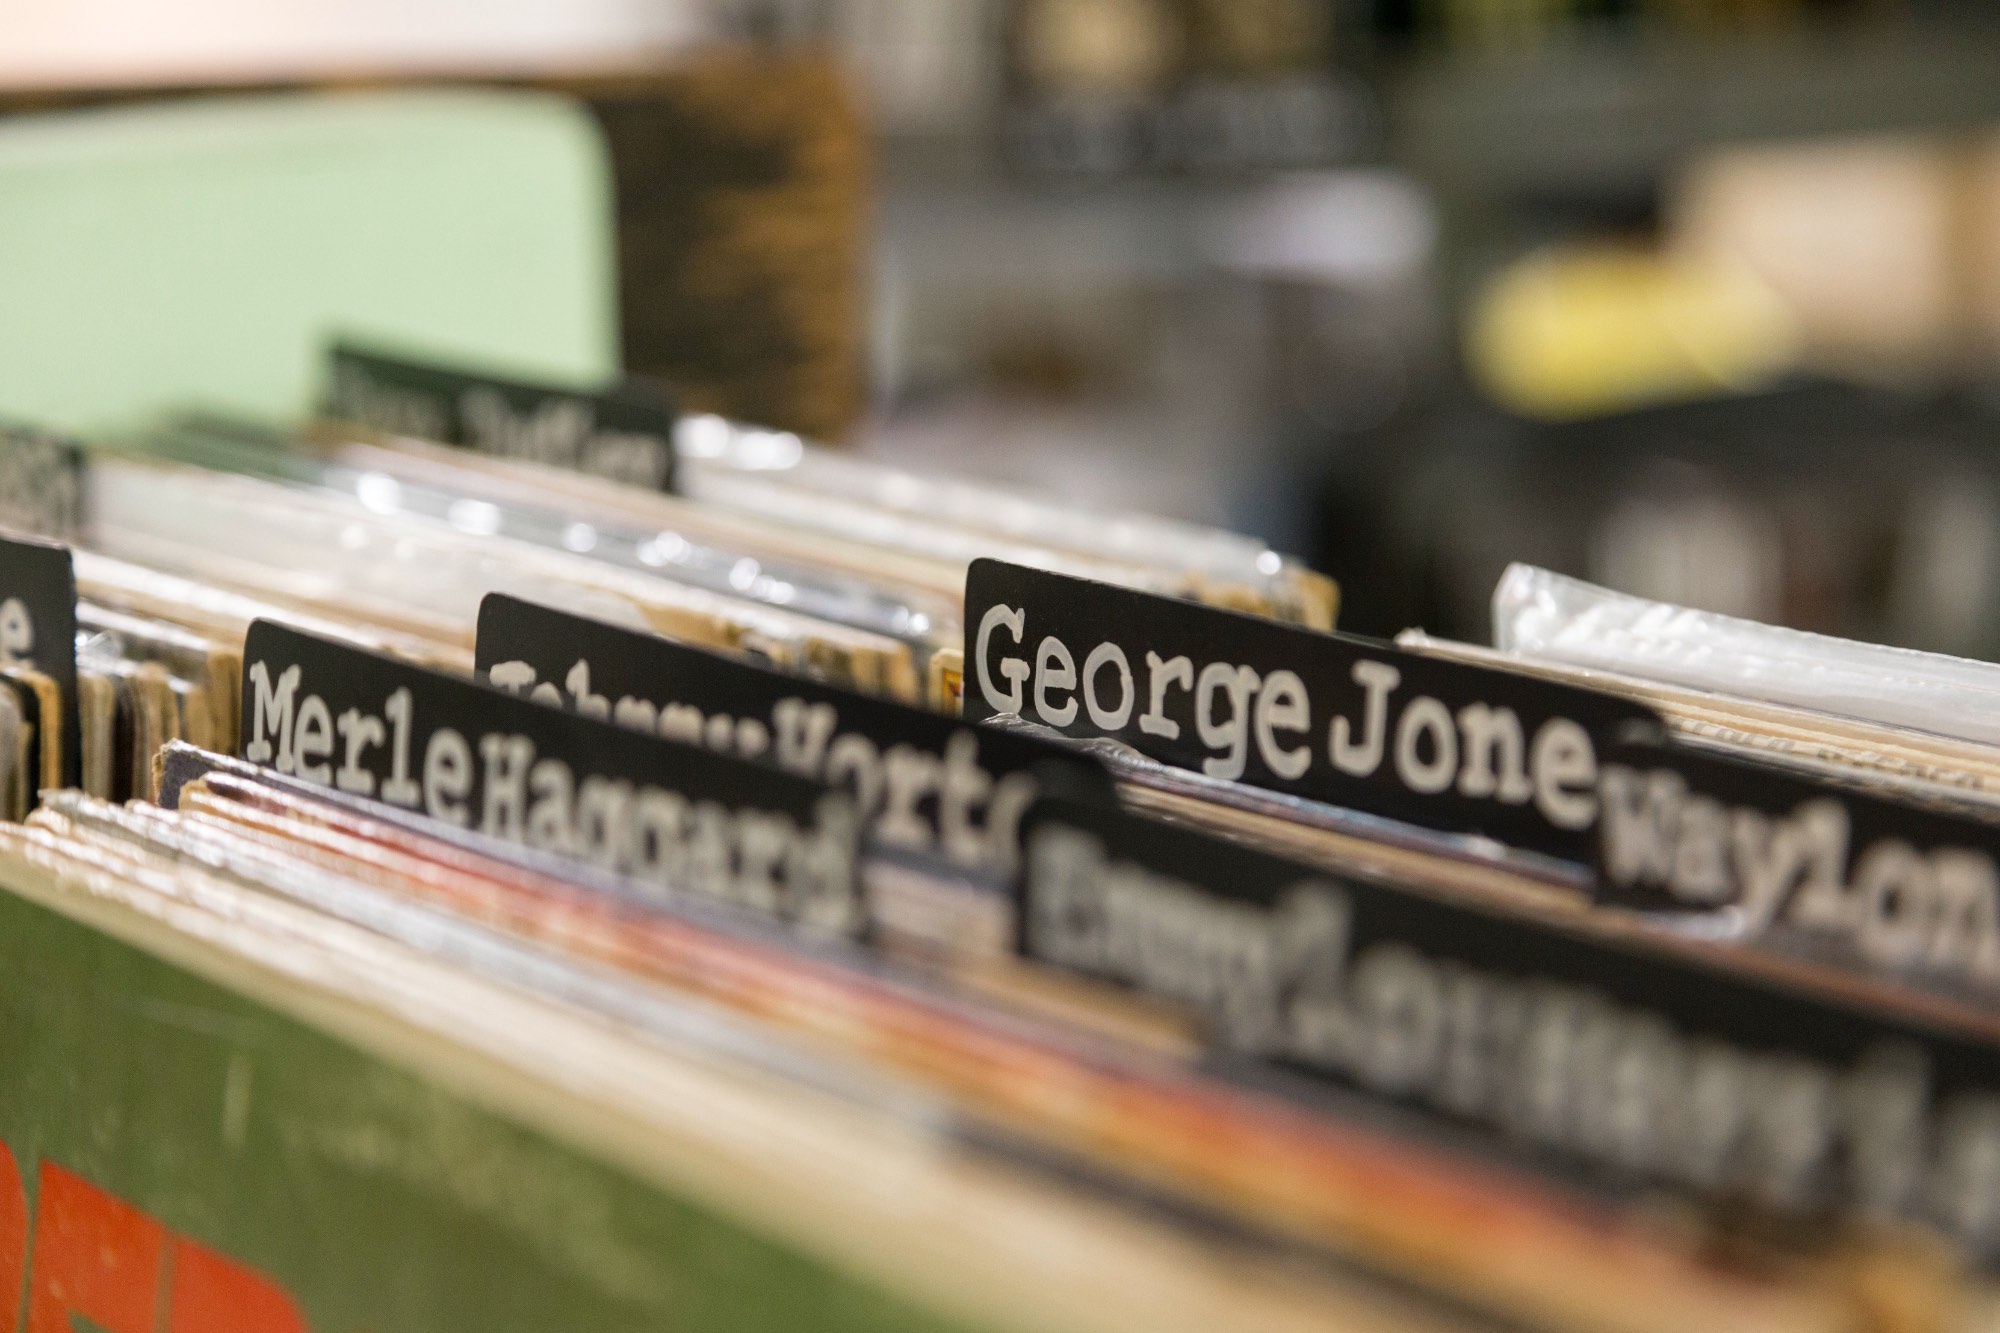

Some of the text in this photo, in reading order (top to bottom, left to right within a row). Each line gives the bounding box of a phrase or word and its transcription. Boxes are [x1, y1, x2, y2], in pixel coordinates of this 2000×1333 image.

[246, 659, 474, 828] Merle
[973, 602, 1313, 782] George
[1329, 658, 1600, 830] Jone
[1598, 761, 2000, 978] Waylon
